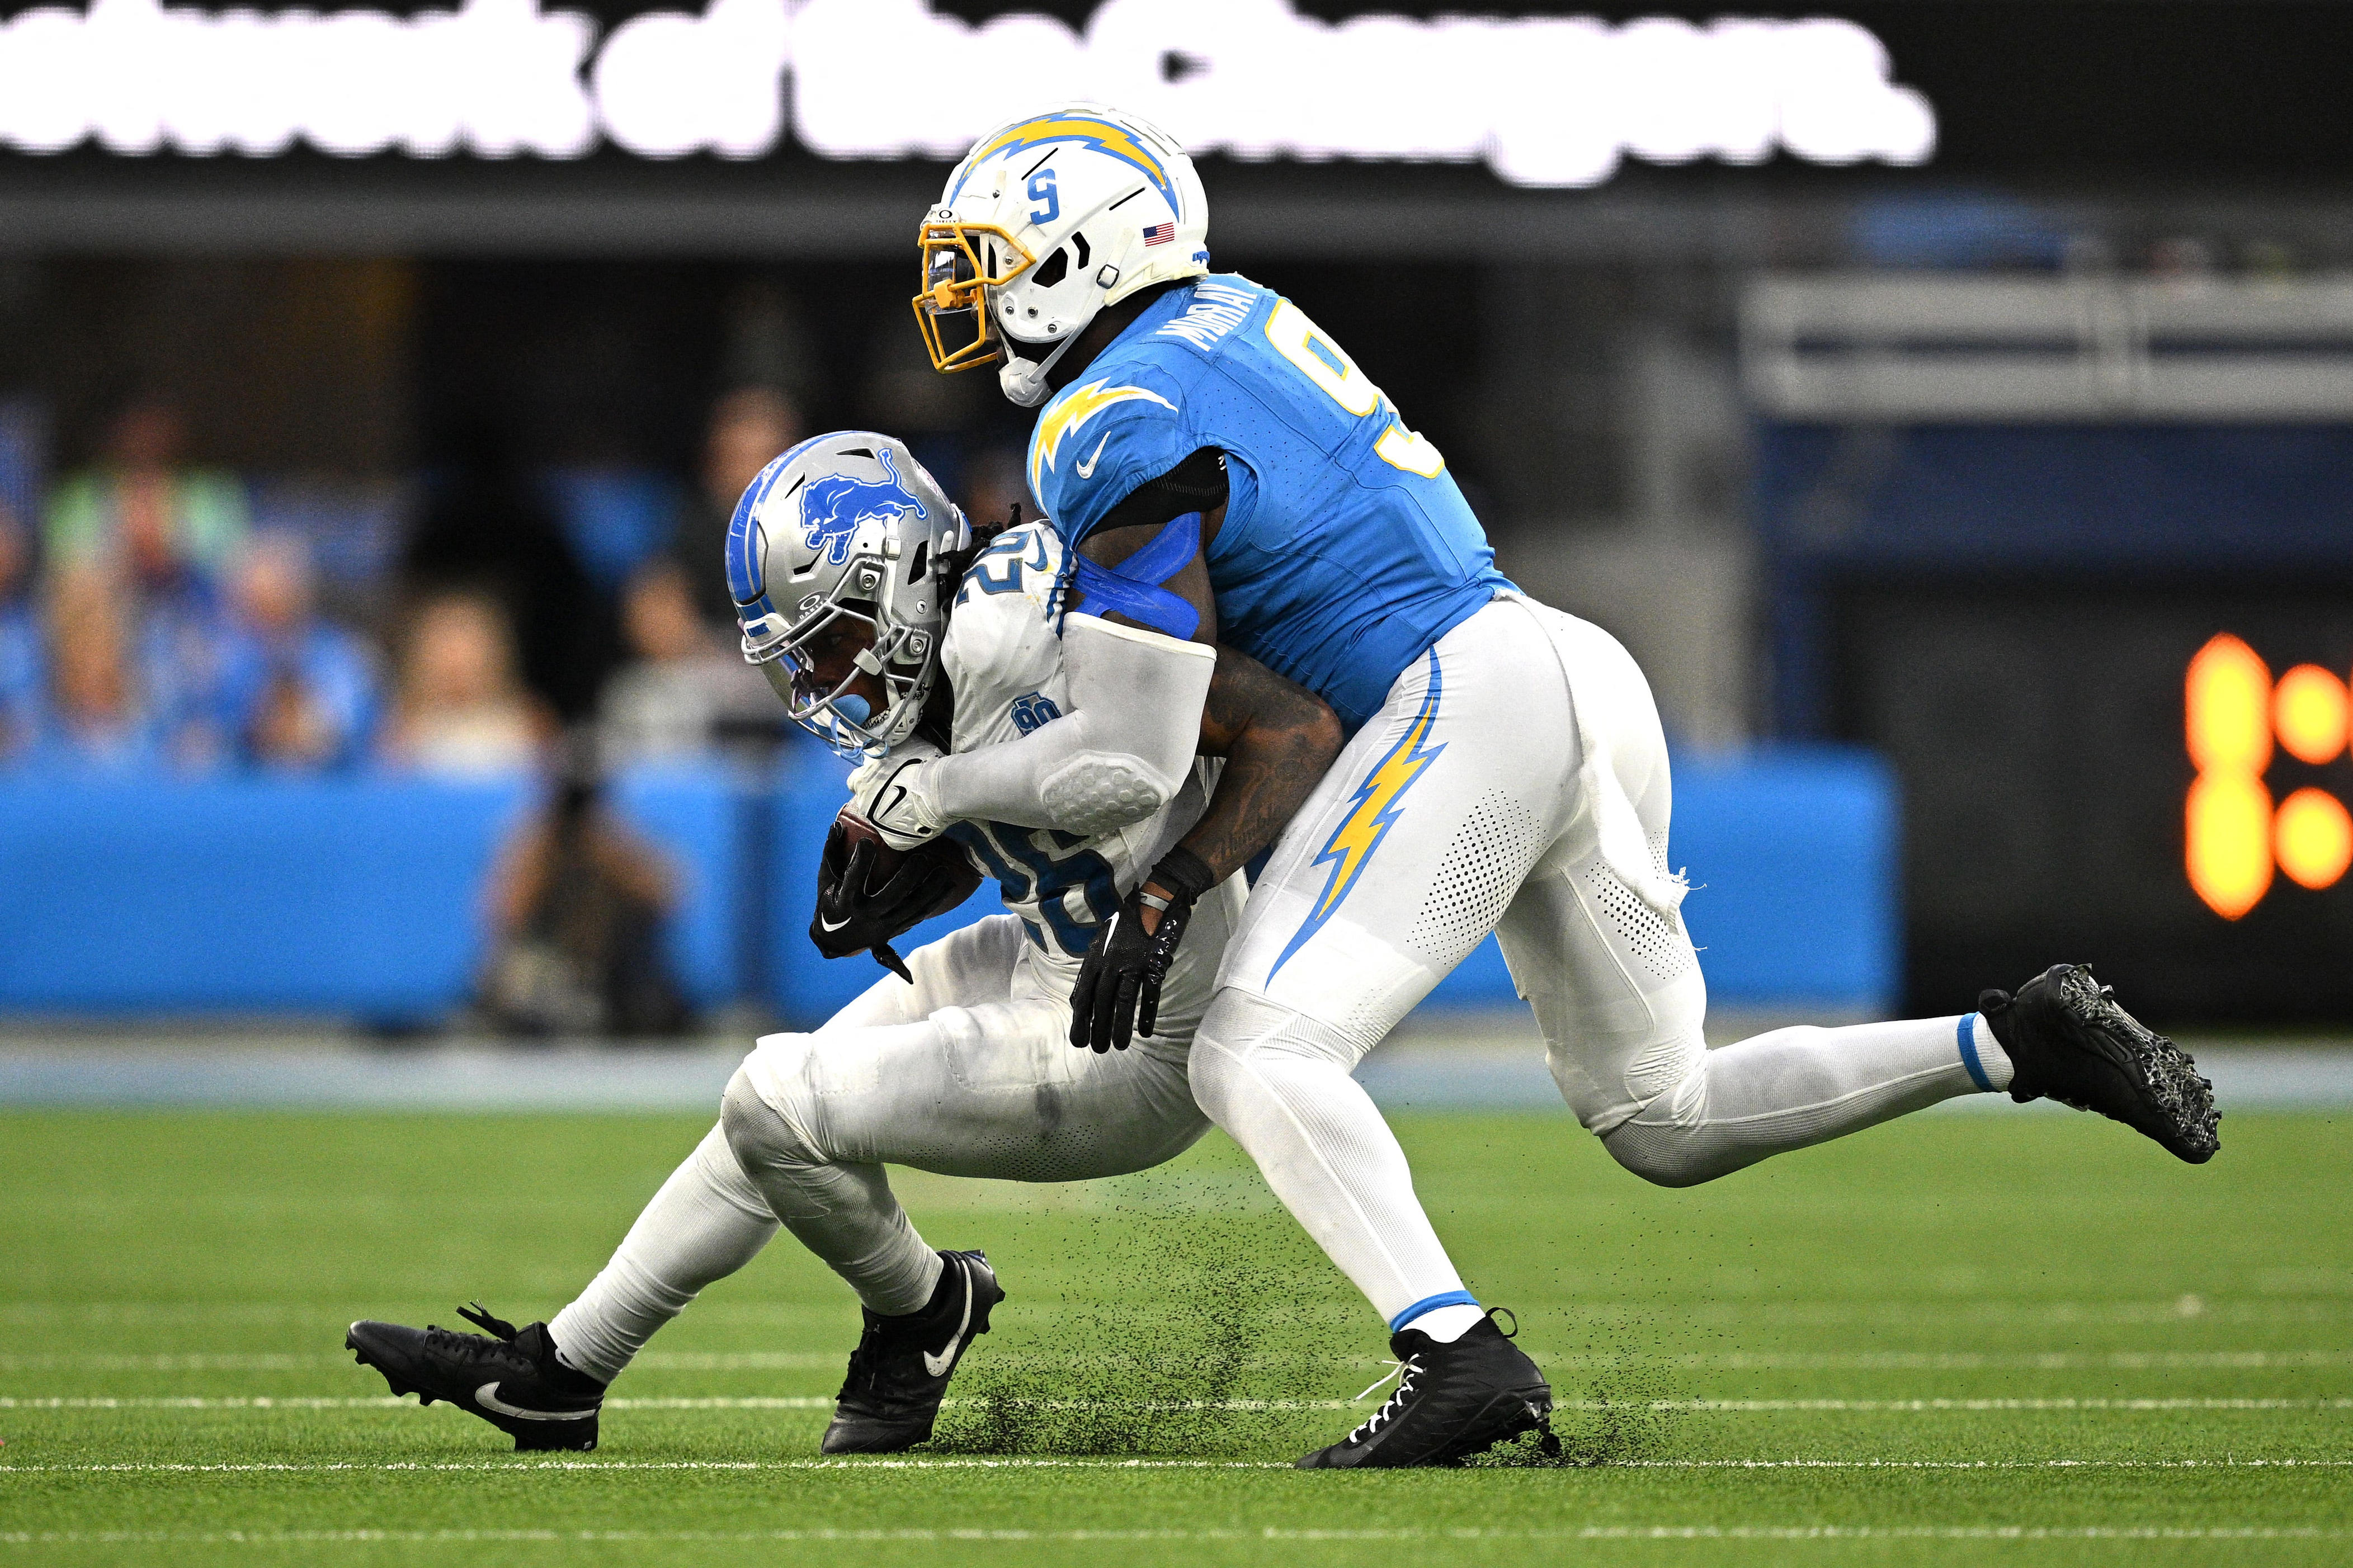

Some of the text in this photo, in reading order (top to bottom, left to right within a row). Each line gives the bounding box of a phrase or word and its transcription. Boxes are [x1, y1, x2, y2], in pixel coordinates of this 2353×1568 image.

[1027, 168, 1059, 225] 9
[1155, 284, 1258, 352] MURRAY
[1264, 297, 1445, 480] 9
